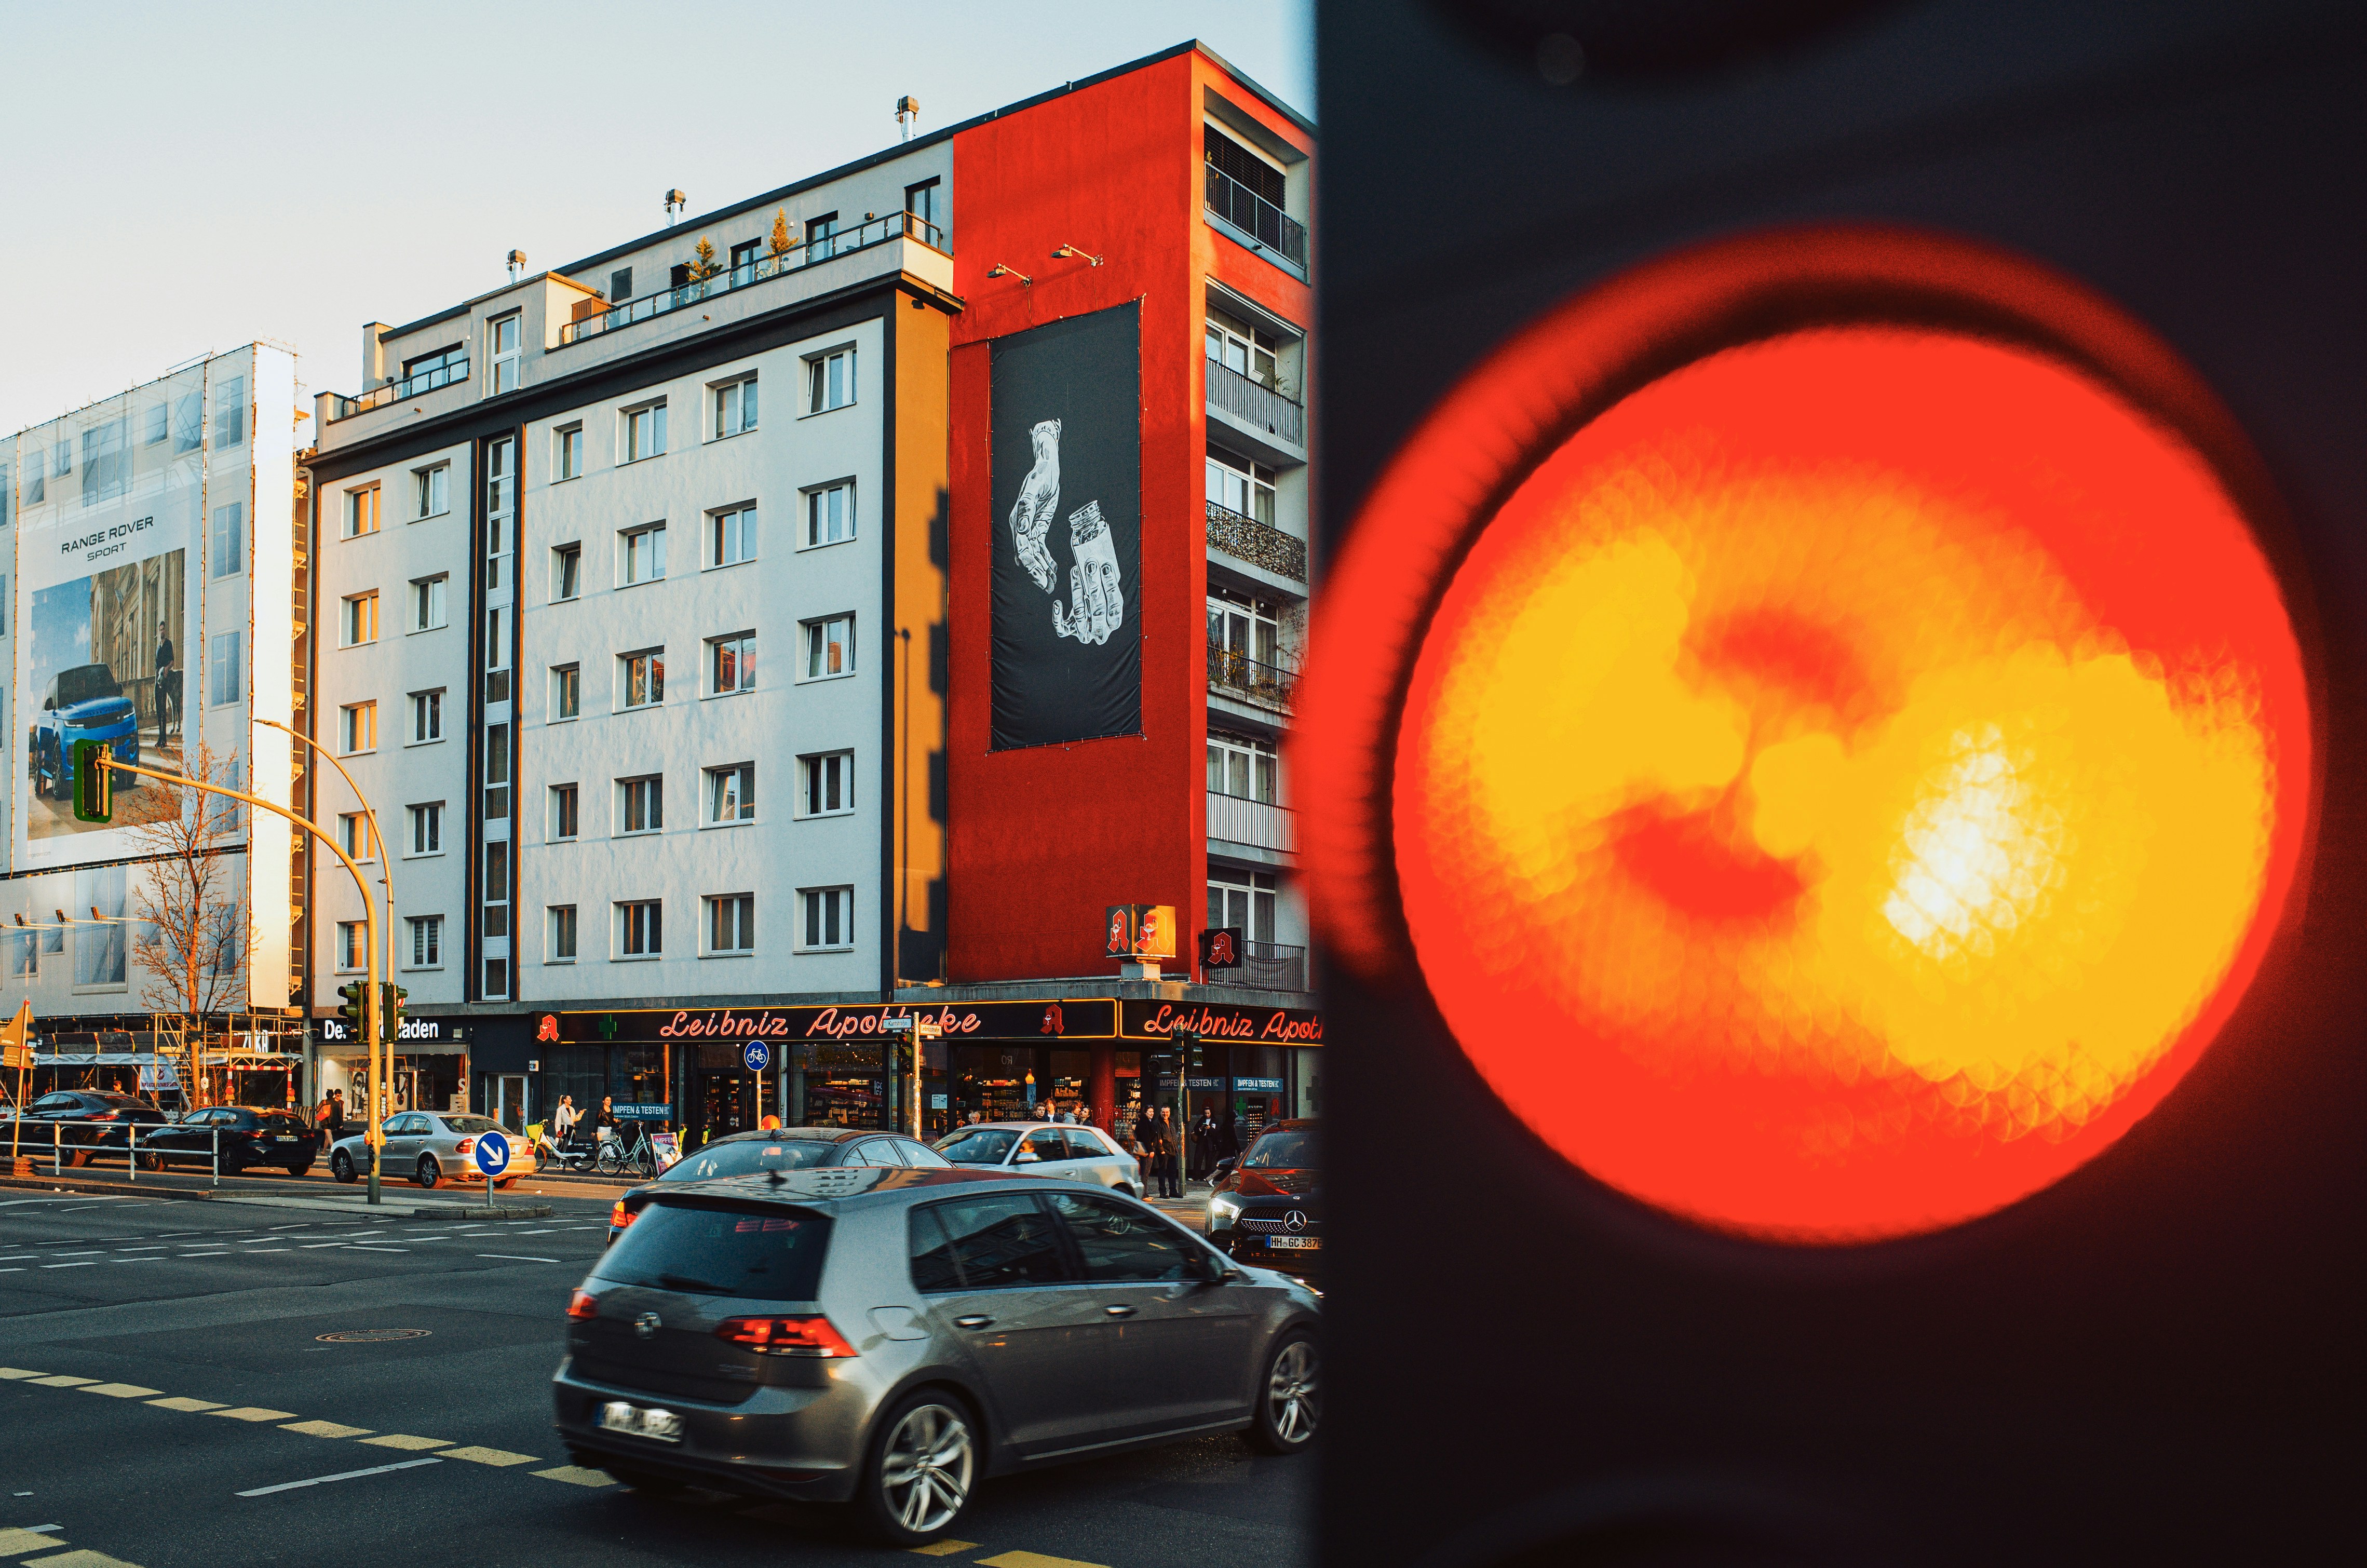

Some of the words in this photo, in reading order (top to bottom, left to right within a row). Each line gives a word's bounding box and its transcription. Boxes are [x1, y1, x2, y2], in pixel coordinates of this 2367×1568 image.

[62, 531, 105, 554] RANGE
[109, 516, 154, 539] ROVER
[87, 542, 127, 561] SPORT
[325, 1020, 346, 1039] De
[660, 1010, 788, 1036] Leibniz
[1144, 1005, 1253, 1036] Leibniz
[1238, 1079, 1254, 1087] IMPFEN
[613, 1105, 634, 1114] IMPFEN
[635, 1106, 640, 1114] &
[641, 1106, 664, 1115] TESTEN
[1271, 1237, 1282, 1247] HH
[1289, 1238, 1300, 1247] GC
